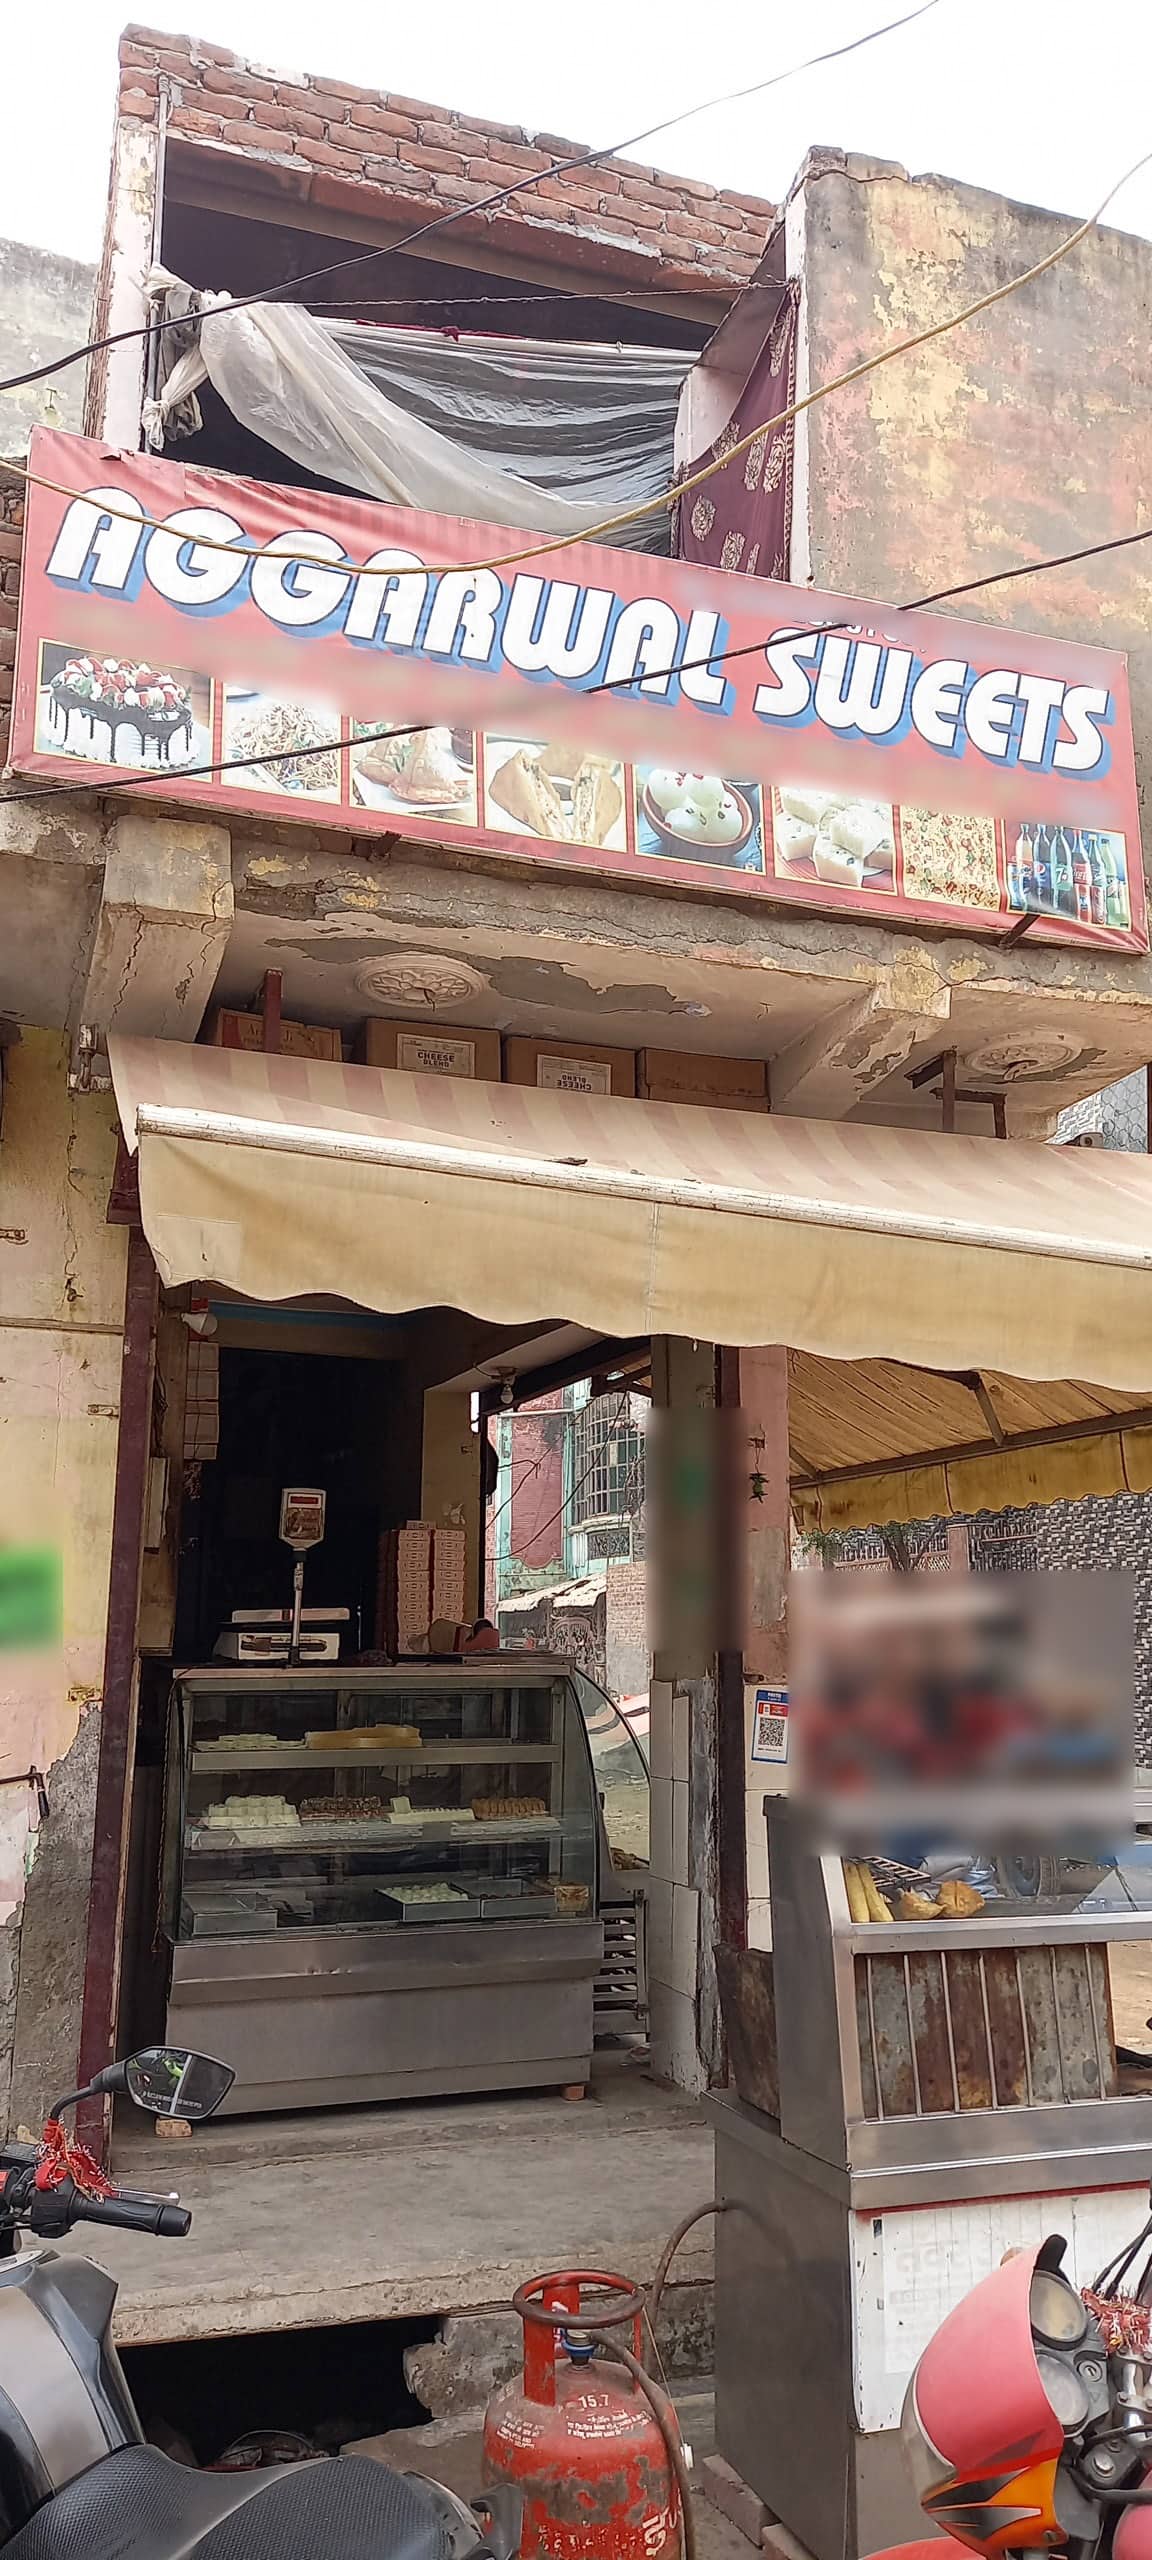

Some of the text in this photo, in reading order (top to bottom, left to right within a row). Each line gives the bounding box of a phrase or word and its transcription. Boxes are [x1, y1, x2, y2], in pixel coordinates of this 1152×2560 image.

[45, 486, 1113, 778] AGGARWAL SWEETS
[417, 1051, 456, 1063] CHEESE
[556, 1079, 592, 1091] CHEESE
[578, 2393, 609, 2409] 15.7
